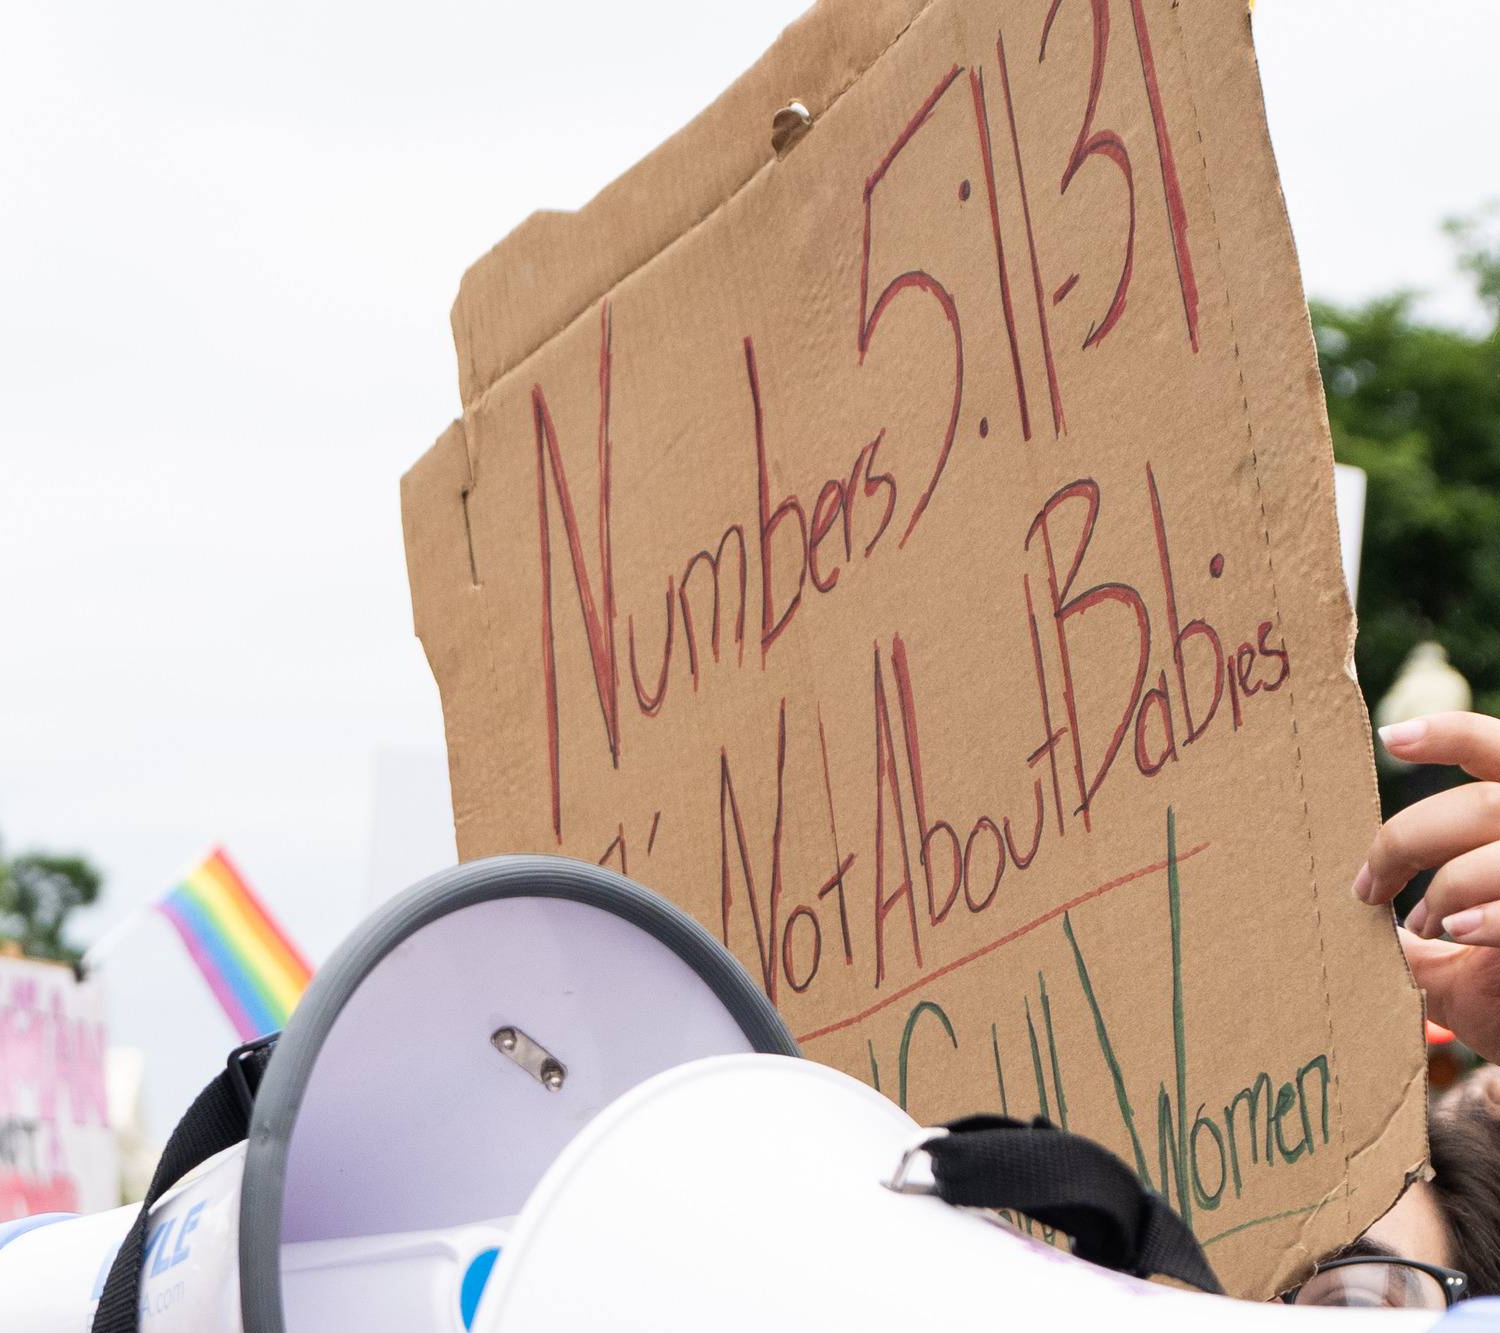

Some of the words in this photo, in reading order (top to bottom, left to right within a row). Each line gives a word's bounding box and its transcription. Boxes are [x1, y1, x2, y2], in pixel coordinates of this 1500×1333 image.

[532, 295, 898, 842] Numbers
[719, 698, 857, 1010] Not
[872, 574, 1082, 988] About
[1026, 463, 1291, 832] Babies
[1064, 806, 1330, 1222] Women
